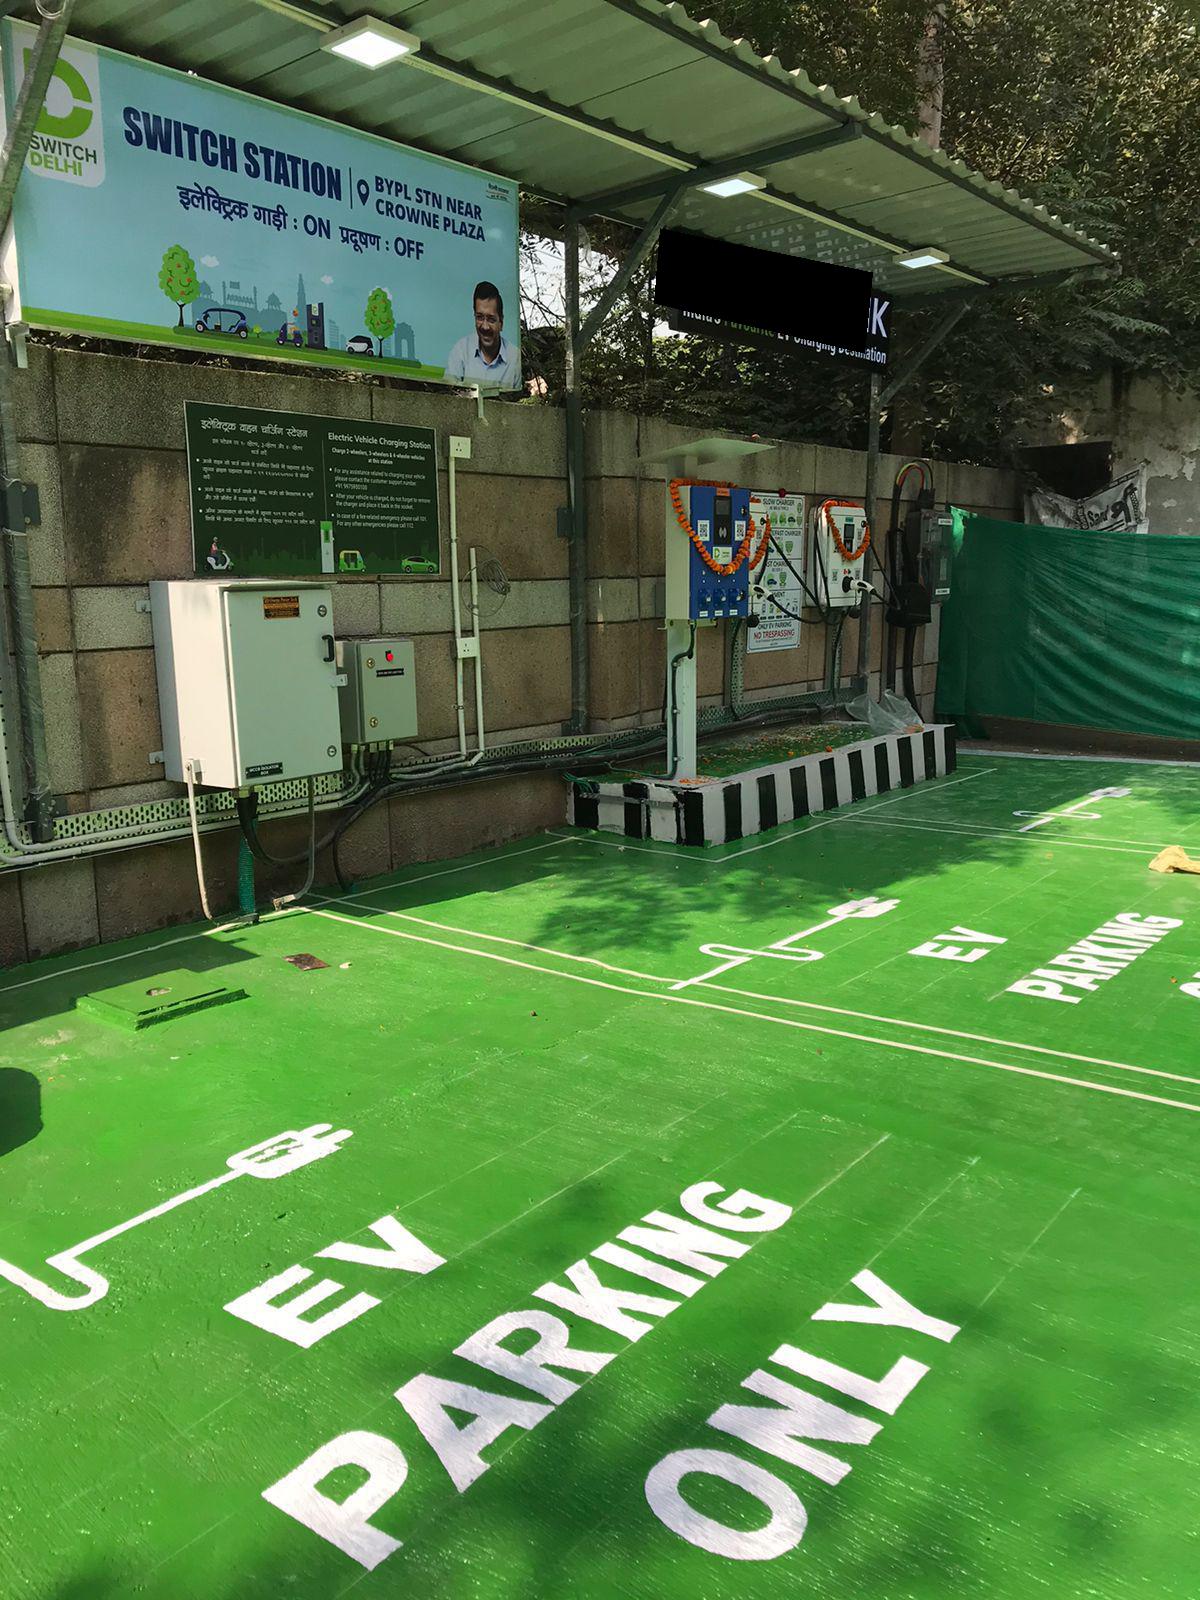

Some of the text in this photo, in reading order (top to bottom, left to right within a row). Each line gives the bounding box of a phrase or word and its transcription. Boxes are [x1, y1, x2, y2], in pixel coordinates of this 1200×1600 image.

[29, 151, 82, 177] DELHI
[30, 135, 97, 164] SWITCH
[123, 106, 342, 201] SWITCH STATION
[374, 175, 482, 221] BYPL STN NEAR
[176, 182, 248, 221] इलेक्ट्रिक
[252, 204, 287, 231] गाड़ी
[303, 214, 331, 240] ON
[338, 225, 381, 254] प्रदूषण
[394, 236, 424, 260] OFF
[375, 199, 485, 242] CROWNE PLAZA
[328, 432, 431, 449] Electric Vehicle Charging Station
[332, 447, 346, 455] Charge
[753, 629, 795, 640] NO TRESPASSING
[907, 925, 1008, 963] EV
[1005, 912, 1184, 1004] PARKING
[223, 1214, 447, 1348] EV
[261, 1181, 793, 1571] PARKING
[644, 1268, 961, 1561] ONLY
